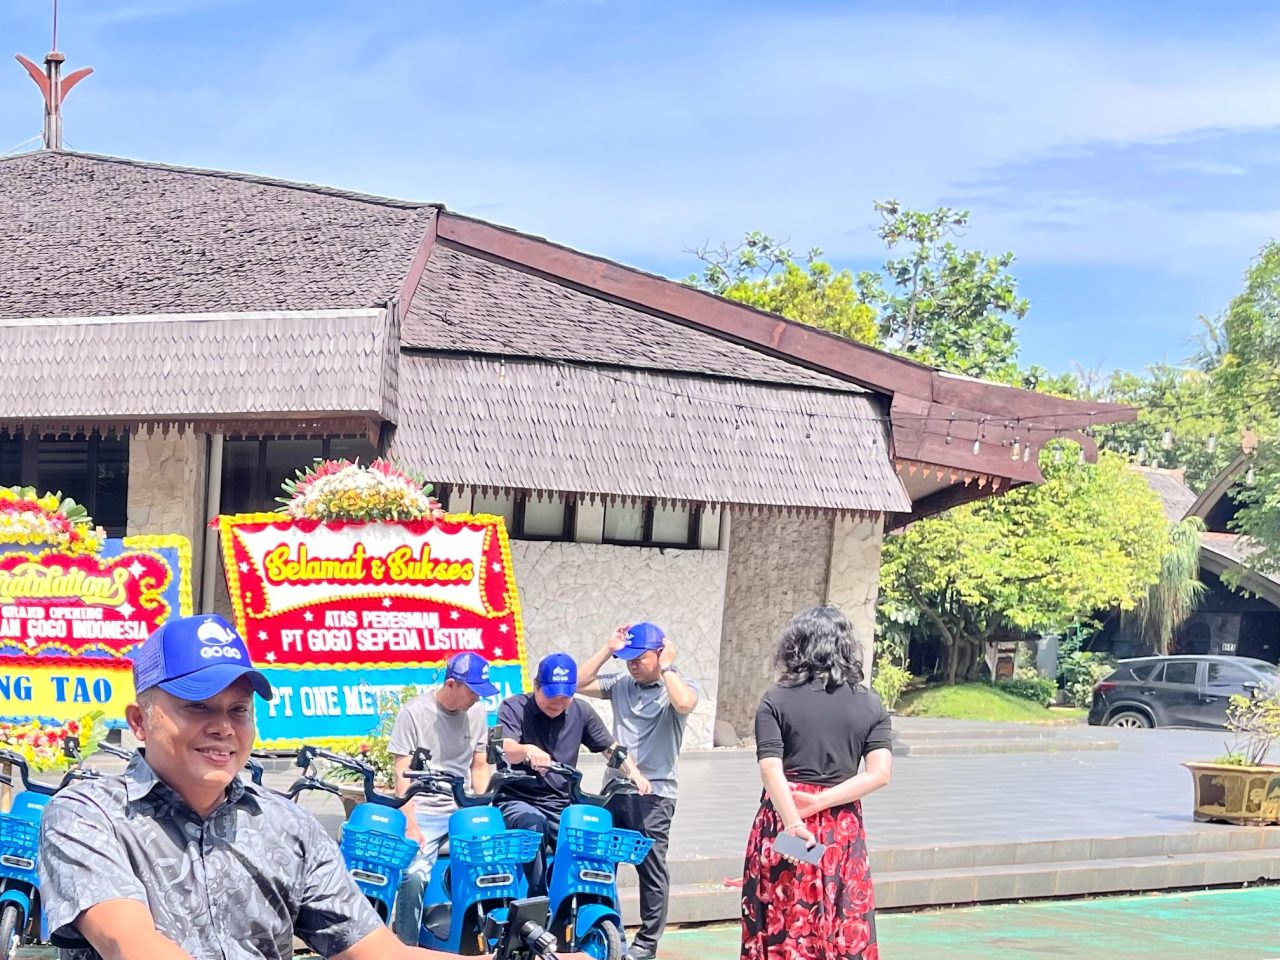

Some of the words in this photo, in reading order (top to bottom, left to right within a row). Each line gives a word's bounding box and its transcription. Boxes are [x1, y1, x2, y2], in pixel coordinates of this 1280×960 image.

[265, 543, 366, 581] Selamat
[371, 562, 386, 578] &
[387, 543, 475, 582] Sukses
[1, 605, 46, 619] GRAND
[49, 607, 104, 620] OPENING
[324, 610, 359, 629] ATAS
[363, 612, 440, 629] PERESMIAN
[27, 619, 67, 639] GOGO
[72, 621, 149, 640] INDONESIA
[281, 629, 304, 651] PT
[307, 630, 353, 651] GOGO
[356, 629, 420, 650] SEPEDA
[423, 629, 485, 650] LISTRIK
[200, 646, 242, 659] GOGO
[50, 676, 112, 703] TAO
[270, 687, 293, 717] PT
[300, 686, 341, 716] ONE
